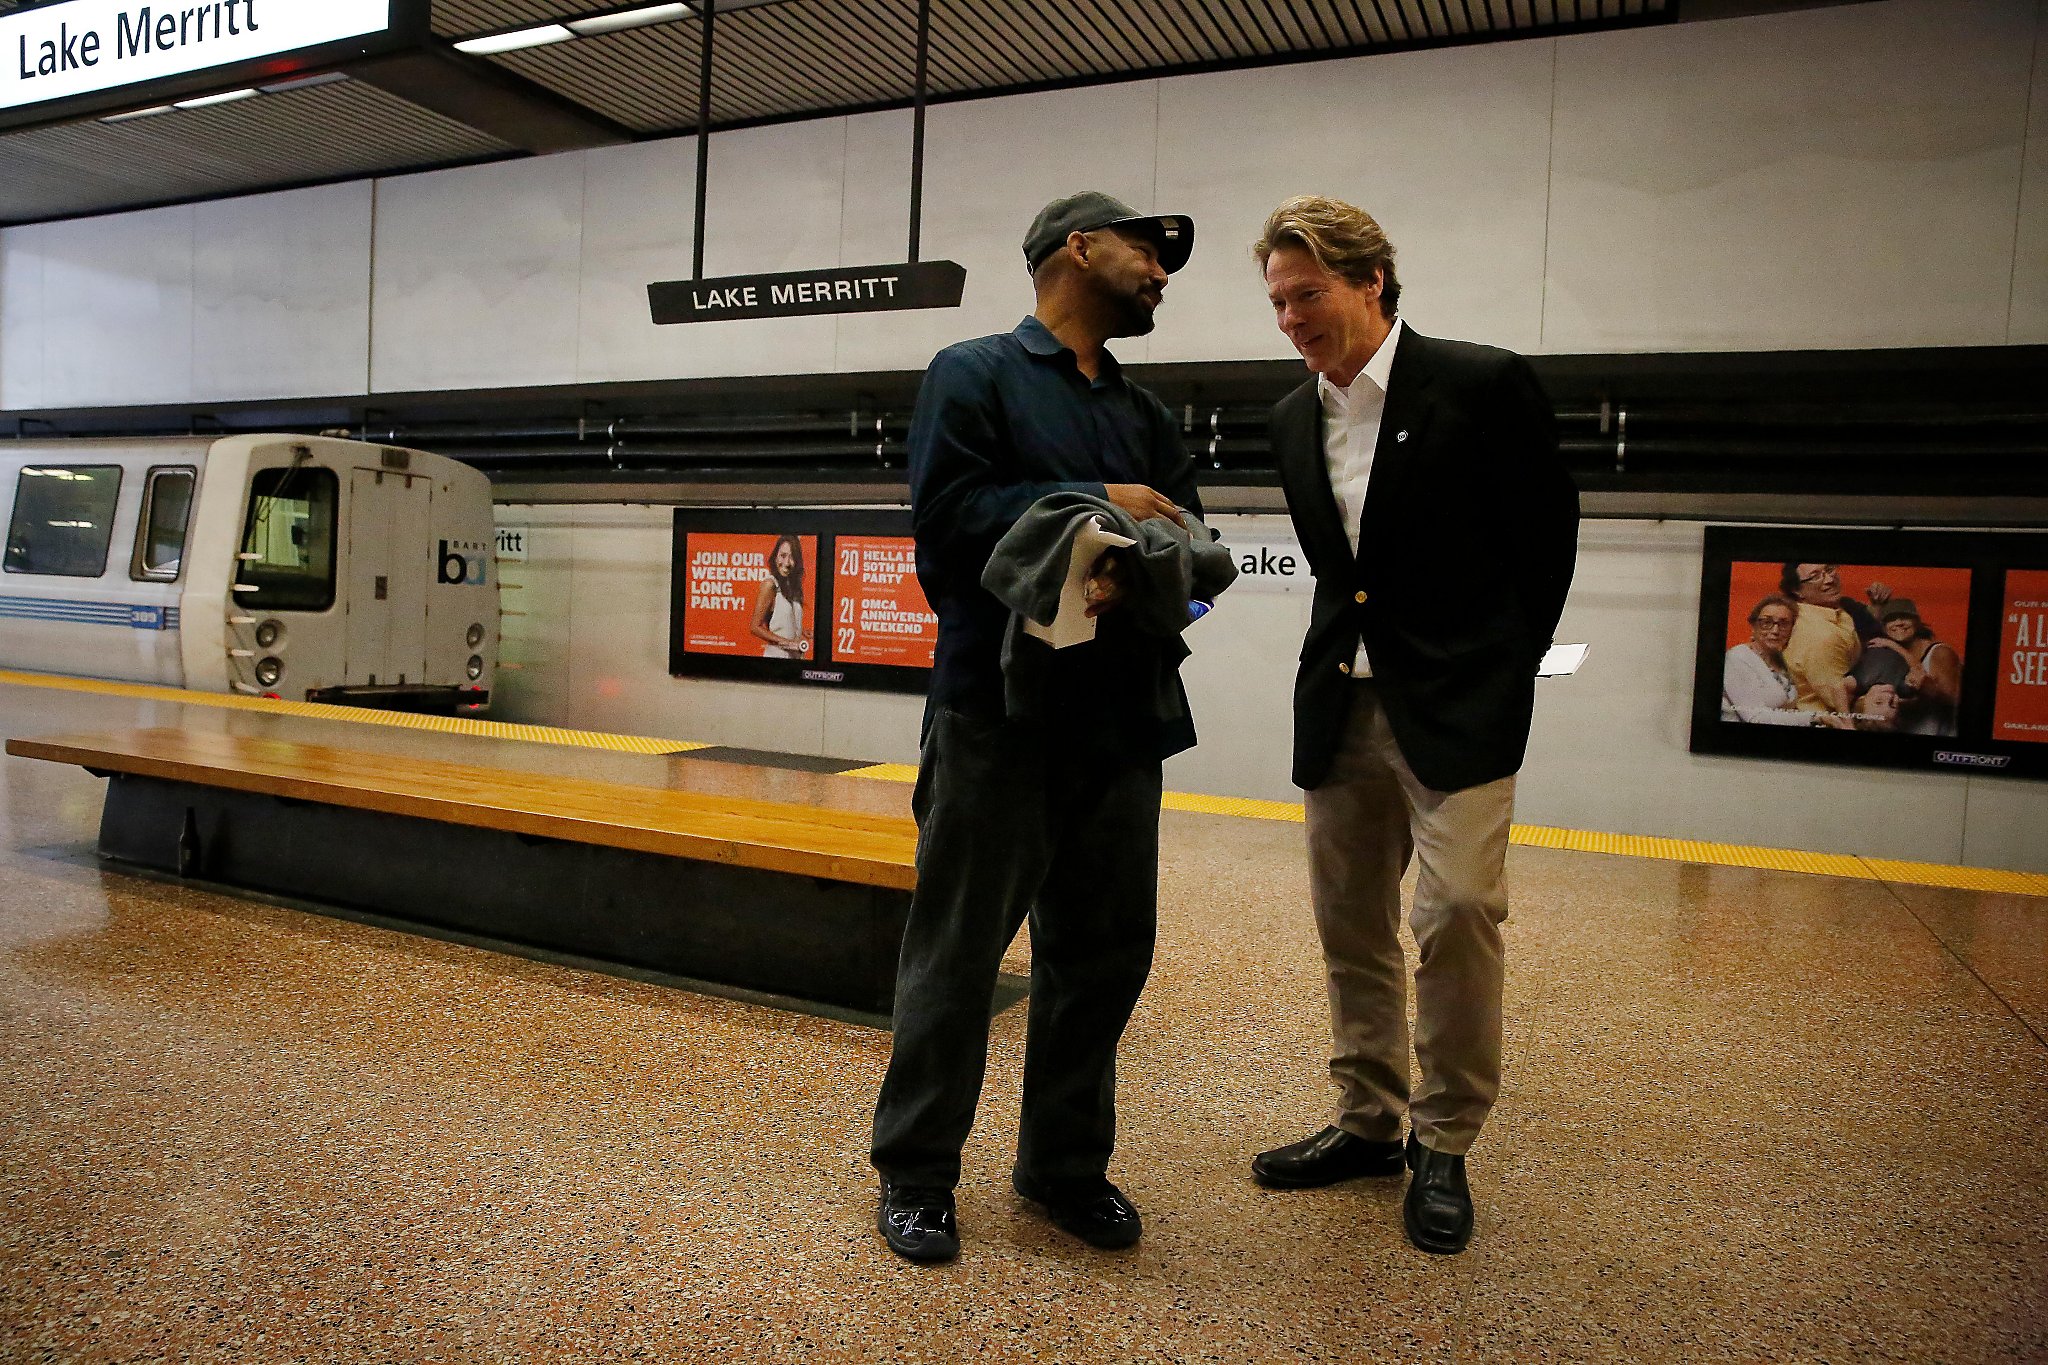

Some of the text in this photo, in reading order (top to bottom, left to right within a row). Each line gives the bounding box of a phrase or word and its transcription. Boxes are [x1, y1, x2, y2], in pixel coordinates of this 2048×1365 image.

[20, 0, 259, 80] Lake Merritt
[692, 276, 899, 309] LAKE MERRITT
[453, 541, 487, 551] BART
[691, 552, 765, 567] JOIN OUR
[841, 549, 859, 576] 20
[863, 550, 904, 562] HELLA
[1227, 547, 1296, 576] ake
[691, 566, 771, 582] WEEKEND
[863, 562, 895, 573] 50TH
[862, 573, 904, 584] PARTY
[690, 581, 733, 595] LONG
[690, 595, 746, 611] PARTY!
[840, 597, 855, 623] 21
[861, 599, 897, 610] OMCA
[860, 621, 923, 634] WEEKEND
[838, 627, 855, 654] 22
[1937, 752, 2004, 765] OUTFRONT
